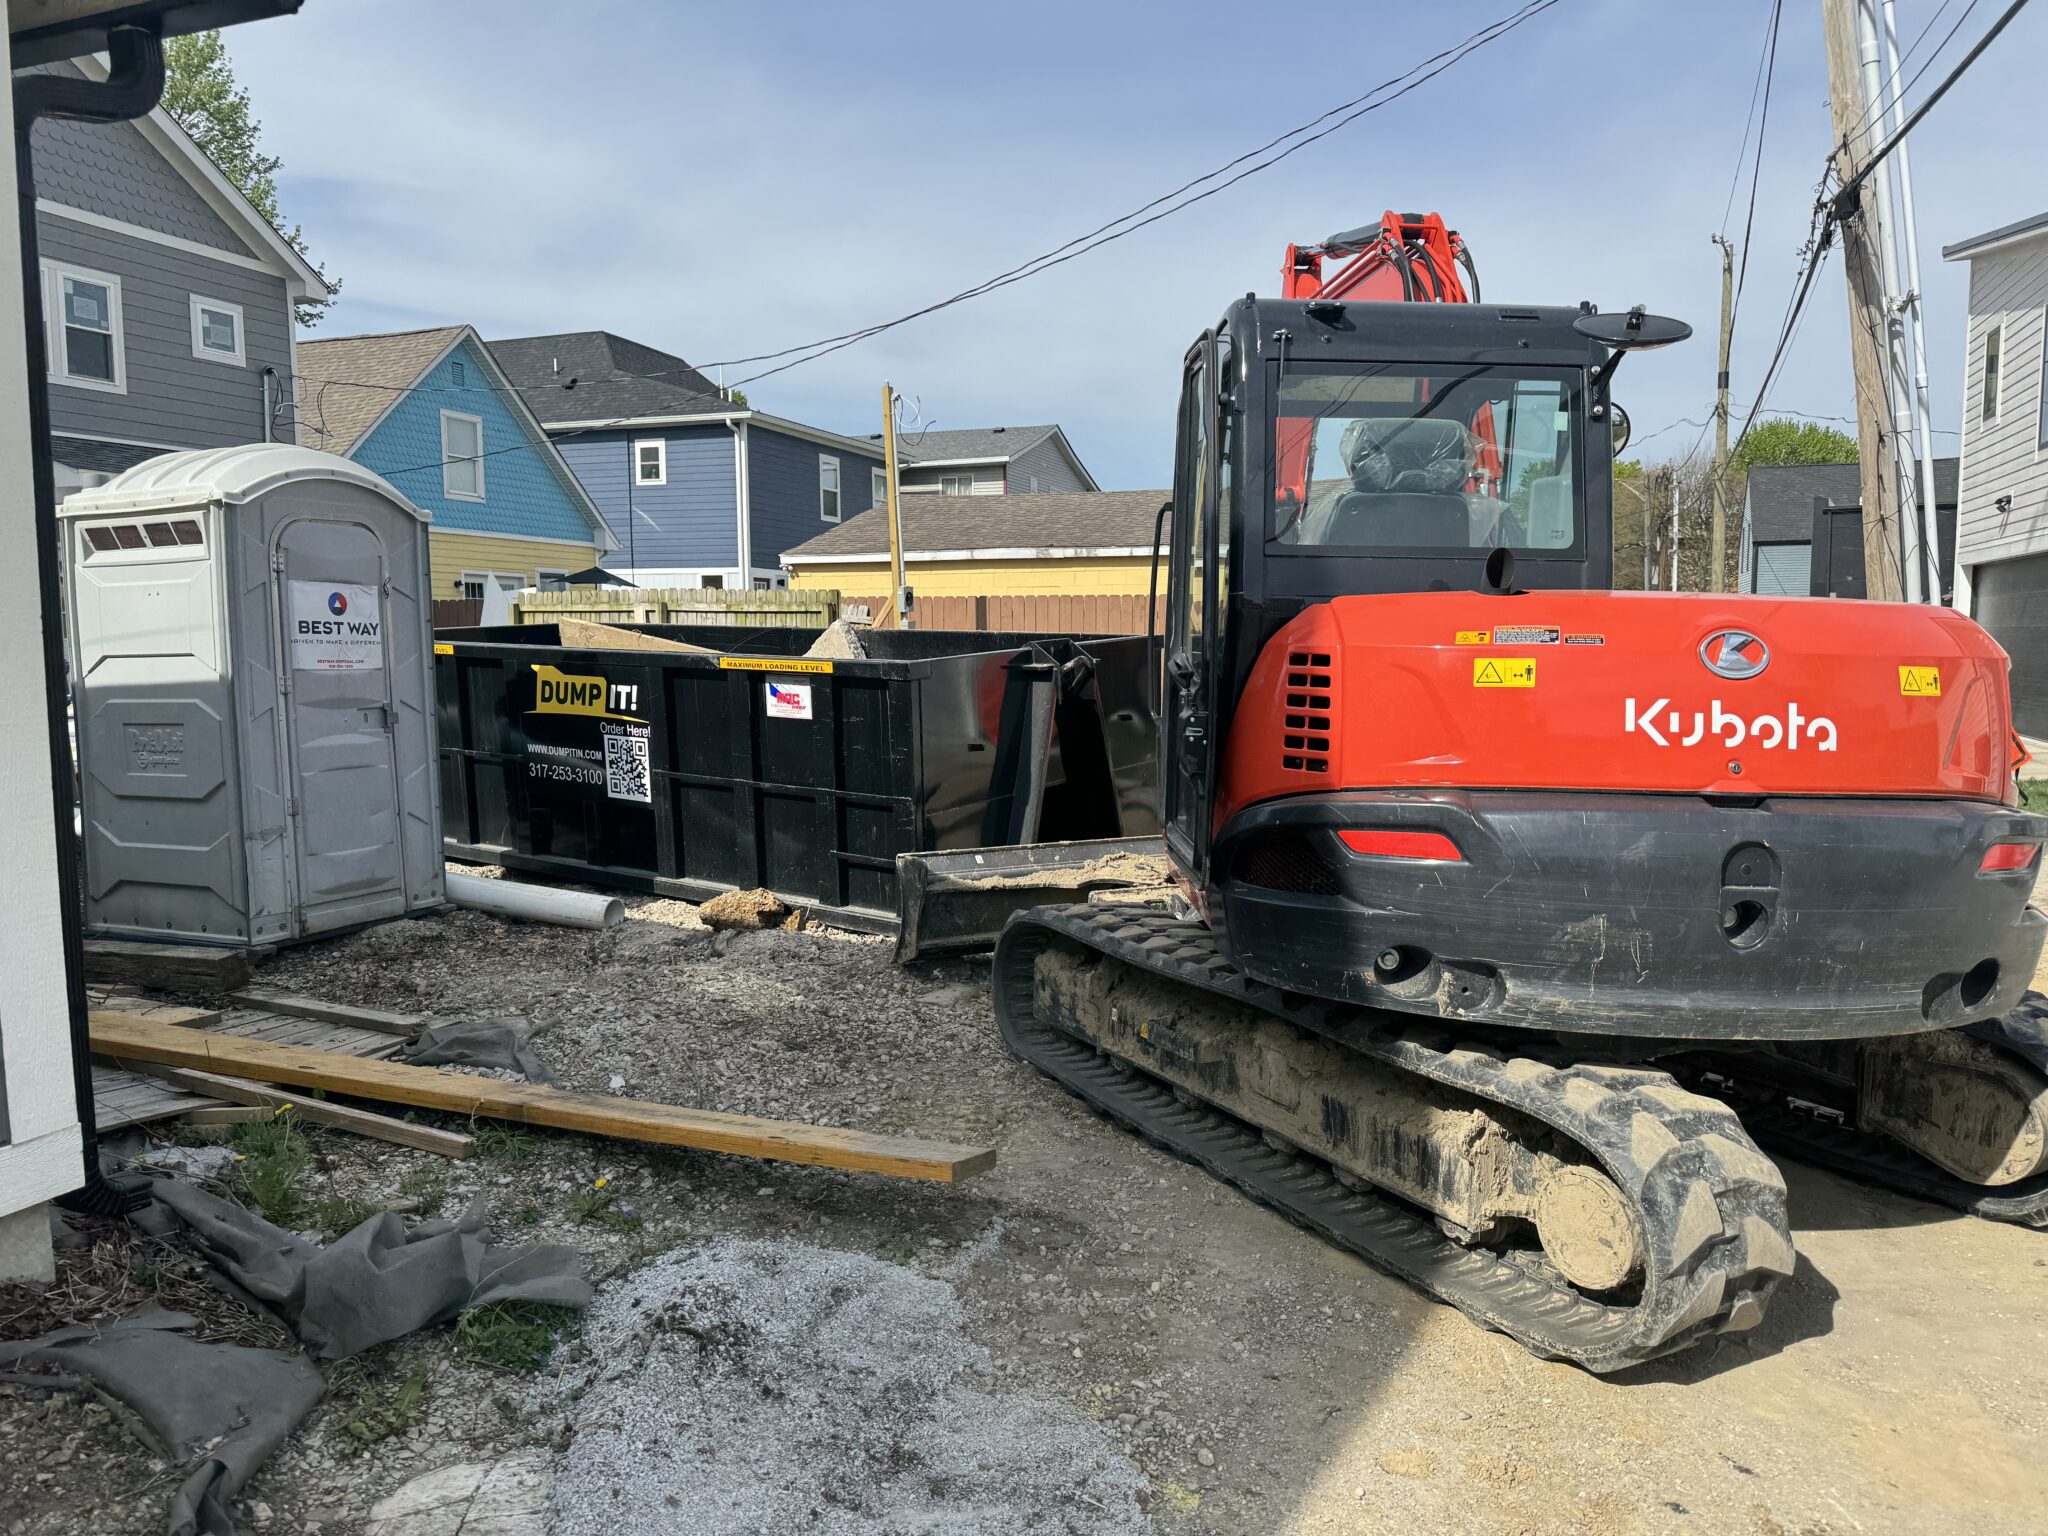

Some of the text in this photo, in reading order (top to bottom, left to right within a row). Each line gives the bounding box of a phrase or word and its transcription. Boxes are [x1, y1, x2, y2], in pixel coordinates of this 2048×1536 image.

[298, 620, 379, 636] BEST WAY
[726, 661, 825, 672] MAXIMUM LOADING LEVEL
[541, 680, 638, 711] DUMP IT!
[600, 721, 651, 738] Order Here!
[1625, 697, 1837, 752] Kubota
[527, 743, 603, 761] WWW.DUMPITIN.COM
[529, 762, 603, 785] 317-253-3100
